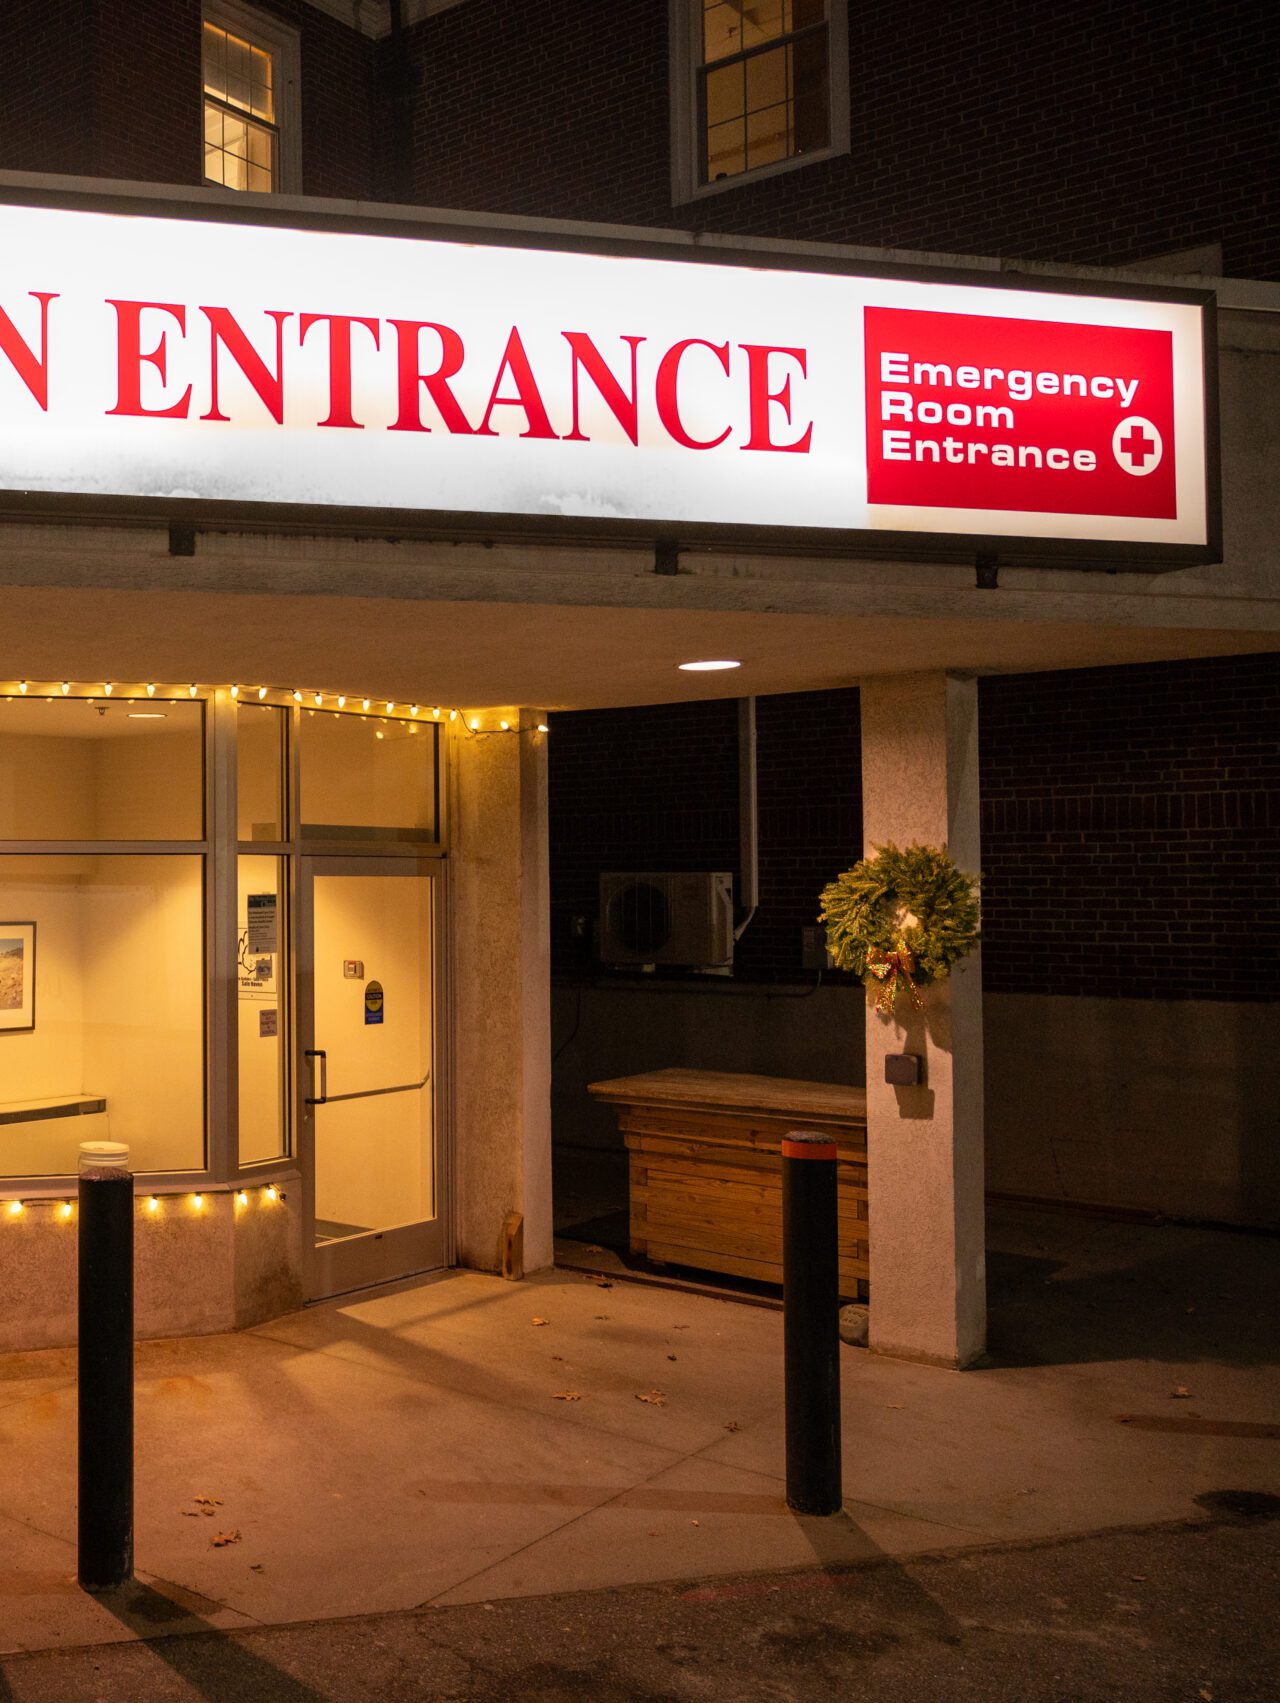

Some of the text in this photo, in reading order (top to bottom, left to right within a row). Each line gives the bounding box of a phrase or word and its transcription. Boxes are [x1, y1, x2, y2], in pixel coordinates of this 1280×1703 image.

[104, 299, 814, 454] ENTRANCE
[880, 351, 1139, 408] Emergency
[880, 390, 1014, 429] Room
[882, 429, 1097, 472] Entrance
